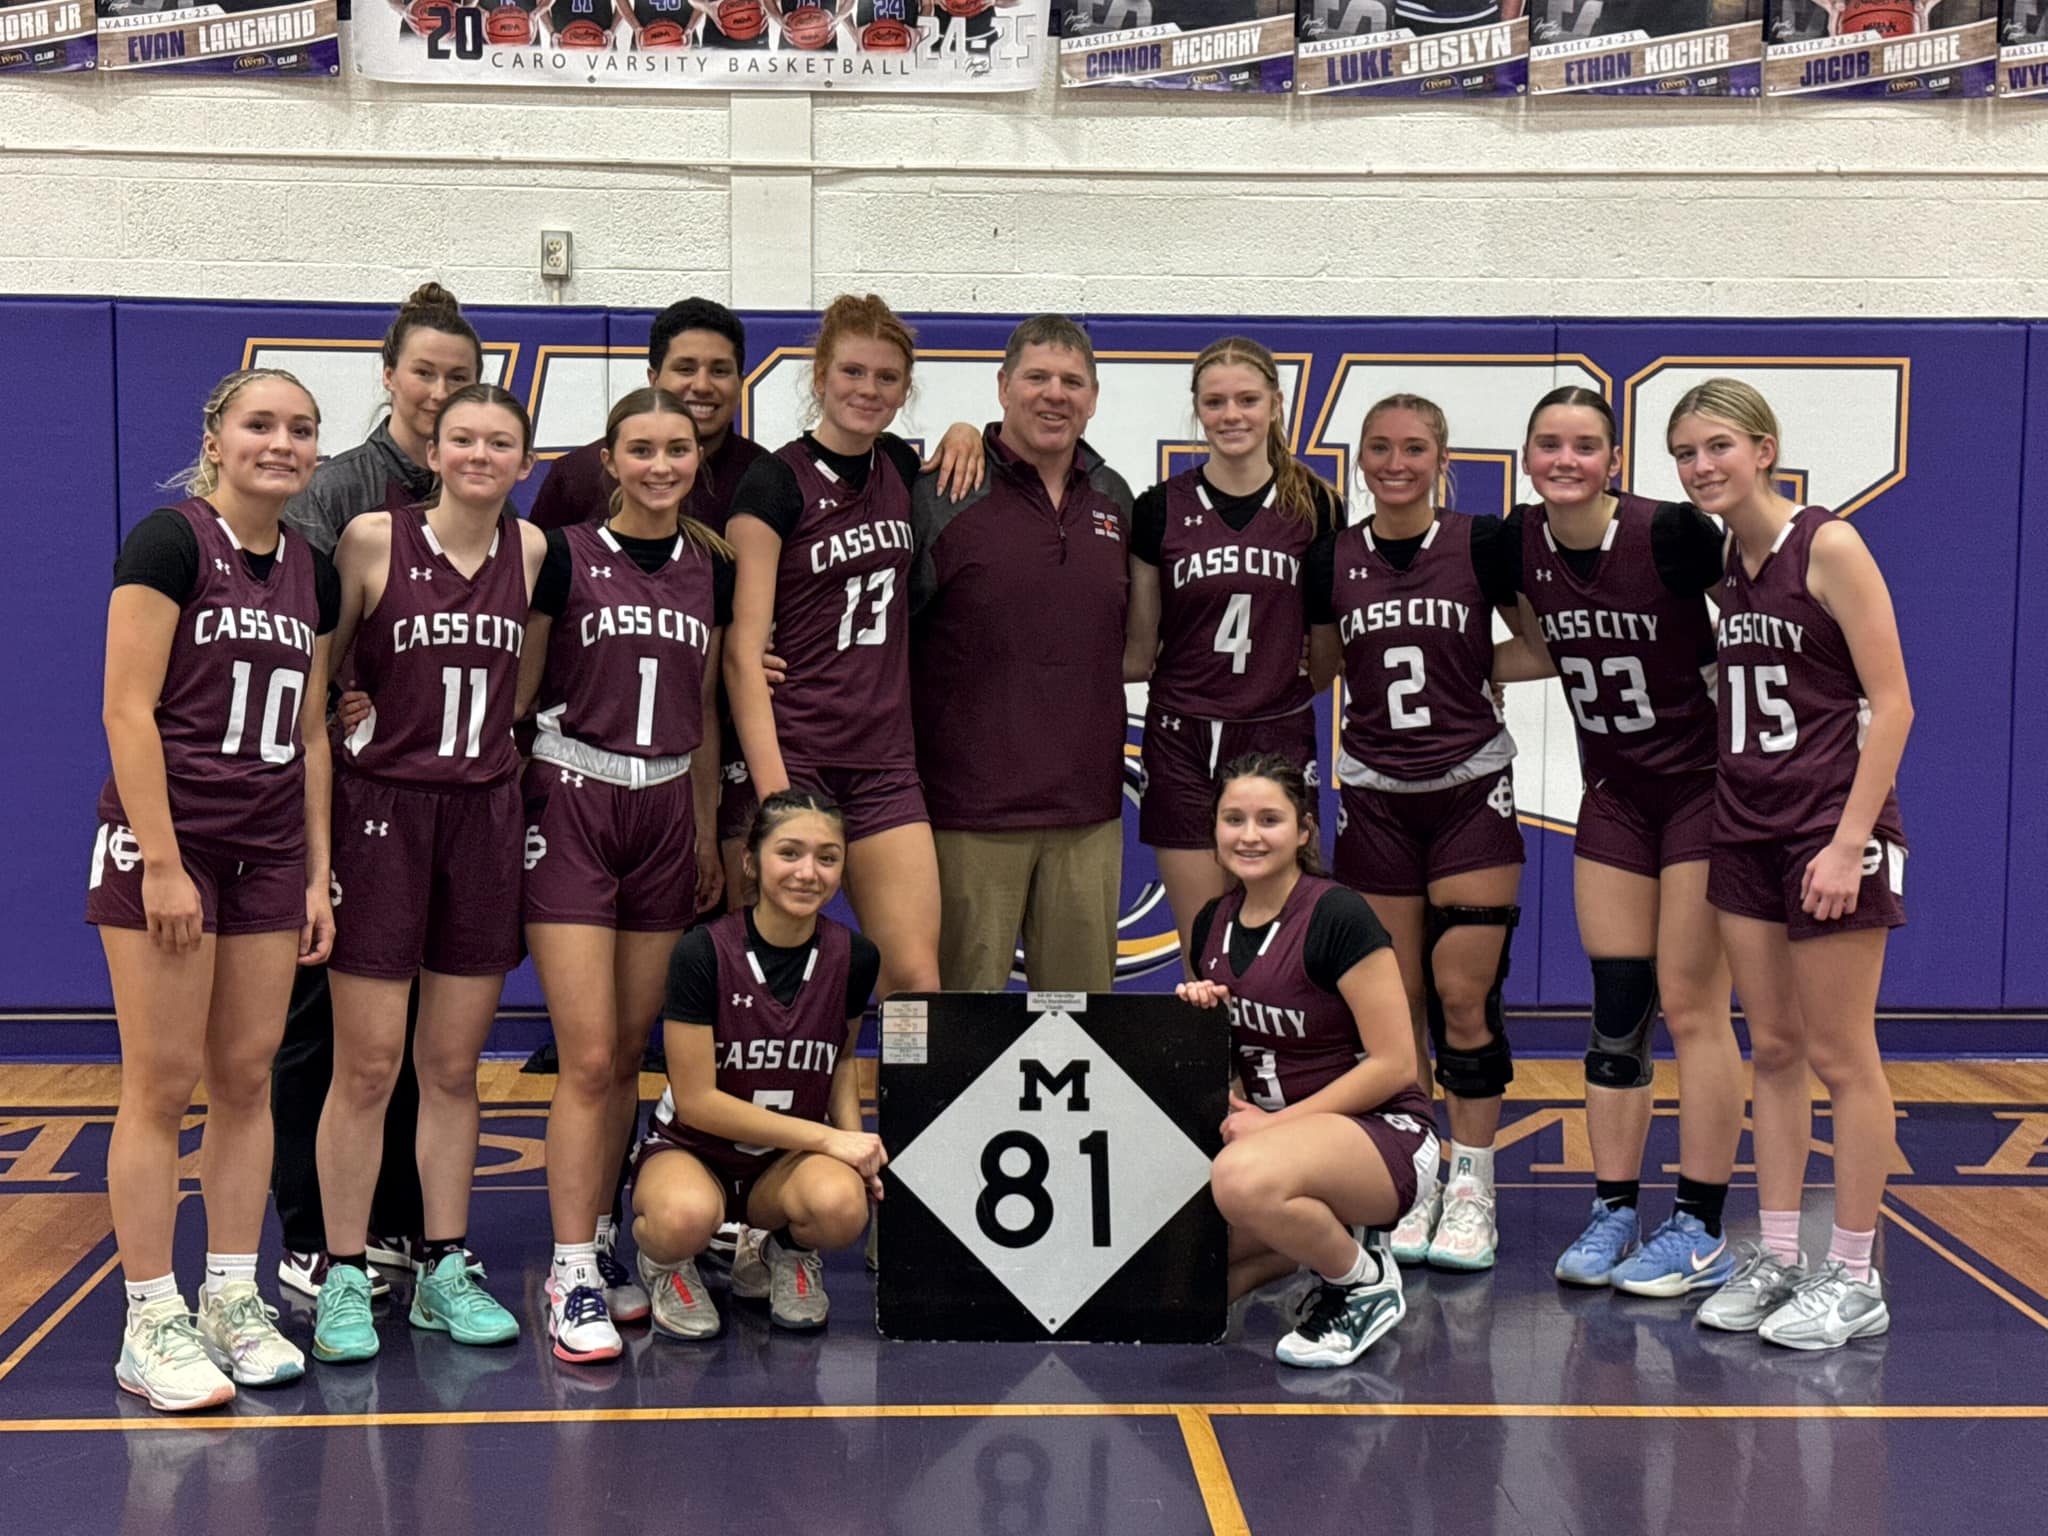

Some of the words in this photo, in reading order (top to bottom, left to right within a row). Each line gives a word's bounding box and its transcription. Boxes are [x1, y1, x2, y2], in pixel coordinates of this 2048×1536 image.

[54, 3, 81, 32] JR
[104, 14, 163, 29] VARSITY
[171, 7, 210, 21] 24-25
[127, 30, 185, 62] EVAN
[198, 9, 316, 53] LANGMAID
[427, 6, 483, 60] 20
[491, 52, 566, 69] CARO
[586, 54, 707, 73] VARSITY
[728, 57, 910, 75] BASKETBALL
[1067, 32, 1122, 49] VARSITY
[1129, 26, 1168, 40] 24-25
[1303, 39, 1355, 53] VARSITY
[1364, 31, 1402, 45] 24-25
[1086, 43, 1162, 78] CONNOR
[1172, 26, 1262, 66] MCGARRY
[1327, 47, 1393, 87] LUKE
[1401, 26, 1512, 75] JOSLYN
[1536, 40, 1591, 56] VARSITY
[1564, 51, 1632, 86] ETHAN
[1644, 34, 1729, 74] KOCHER
[1773, 41, 1824, 56] VARSITY
[1800, 51, 1871, 86] JACOB
[1883, 35, 1960, 74] MOORE
[810, 524, 875, 574] CASS
[1173, 545, 1240, 589] CASS
[1245, 547, 1300, 587] CITY
[194, 607, 273, 645] CASS
[581, 605, 653, 647] CASS
[658, 607, 711, 656] CITY
[837, 567, 896, 651] 13
[1213, 593, 1252, 675] 4
[1339, 600, 1401, 644] CASS
[1407, 598, 1470, 634] CITY
[1595, 610, 1658, 642] CITY
[1717, 612, 1753, 652] ASS
[1752, 612, 1803, 653] CITY
[393, 612, 469, 653] CASS
[476, 613, 525, 658] CITY
[221, 660, 304, 764] 10
[438, 666, 488, 758] 11
[635, 657, 658, 747] 1
[1383, 645, 1431, 730] 2
[1560, 655, 1656, 734] 23
[1728, 665, 1798, 754] 15
[1241, 998, 1306, 1038] CITY
[788, 1039, 838, 1075] CITY
[1240, 1044, 1286, 1113] 3
[1019, 1059, 1090, 1112] M
[975, 1130, 1112, 1248] 81
